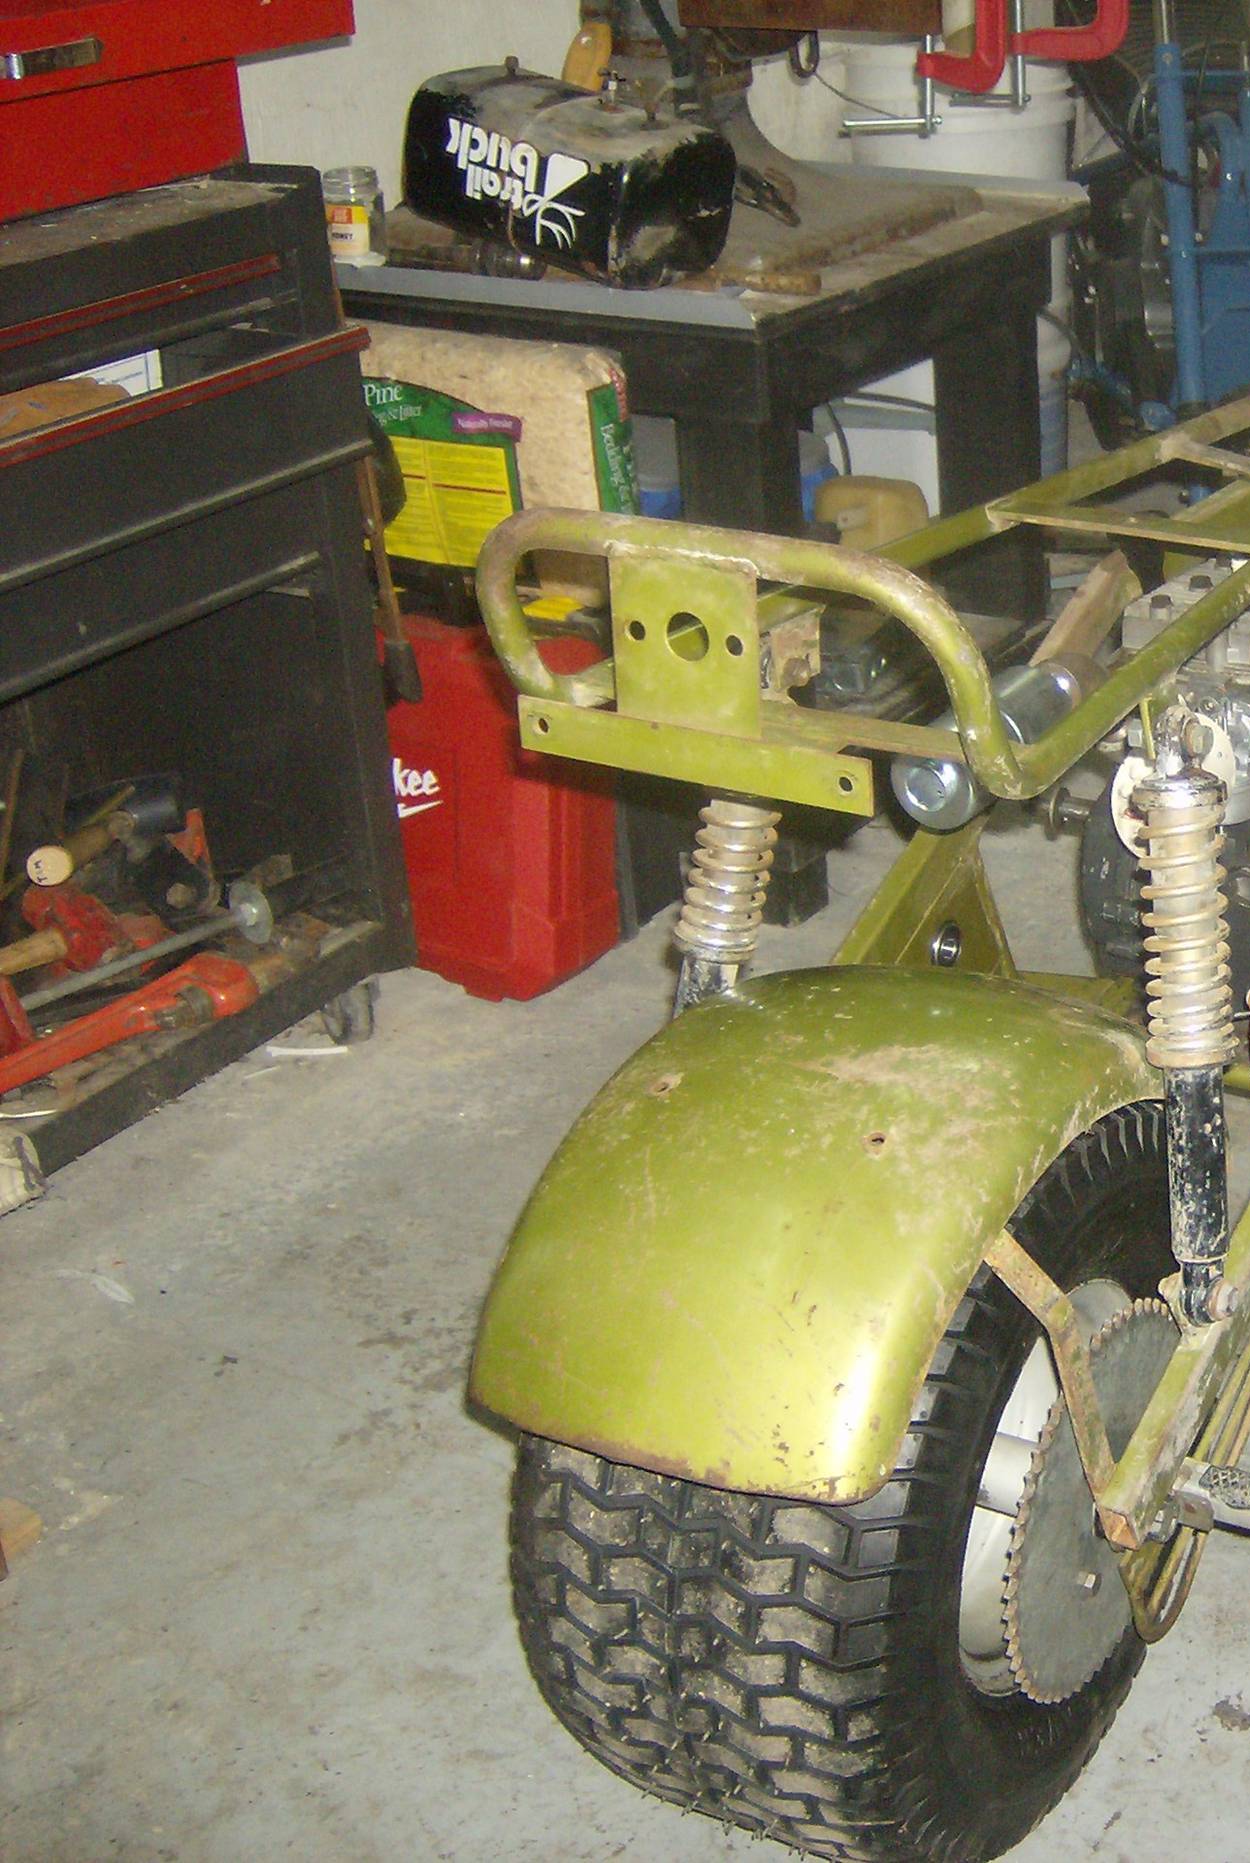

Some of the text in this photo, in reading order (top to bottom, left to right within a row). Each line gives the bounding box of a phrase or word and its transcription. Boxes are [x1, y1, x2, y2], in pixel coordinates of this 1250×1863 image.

[445, 117, 538, 195] buck
[465, 162, 525, 213] trail
[362, 383, 403, 406] Pine
